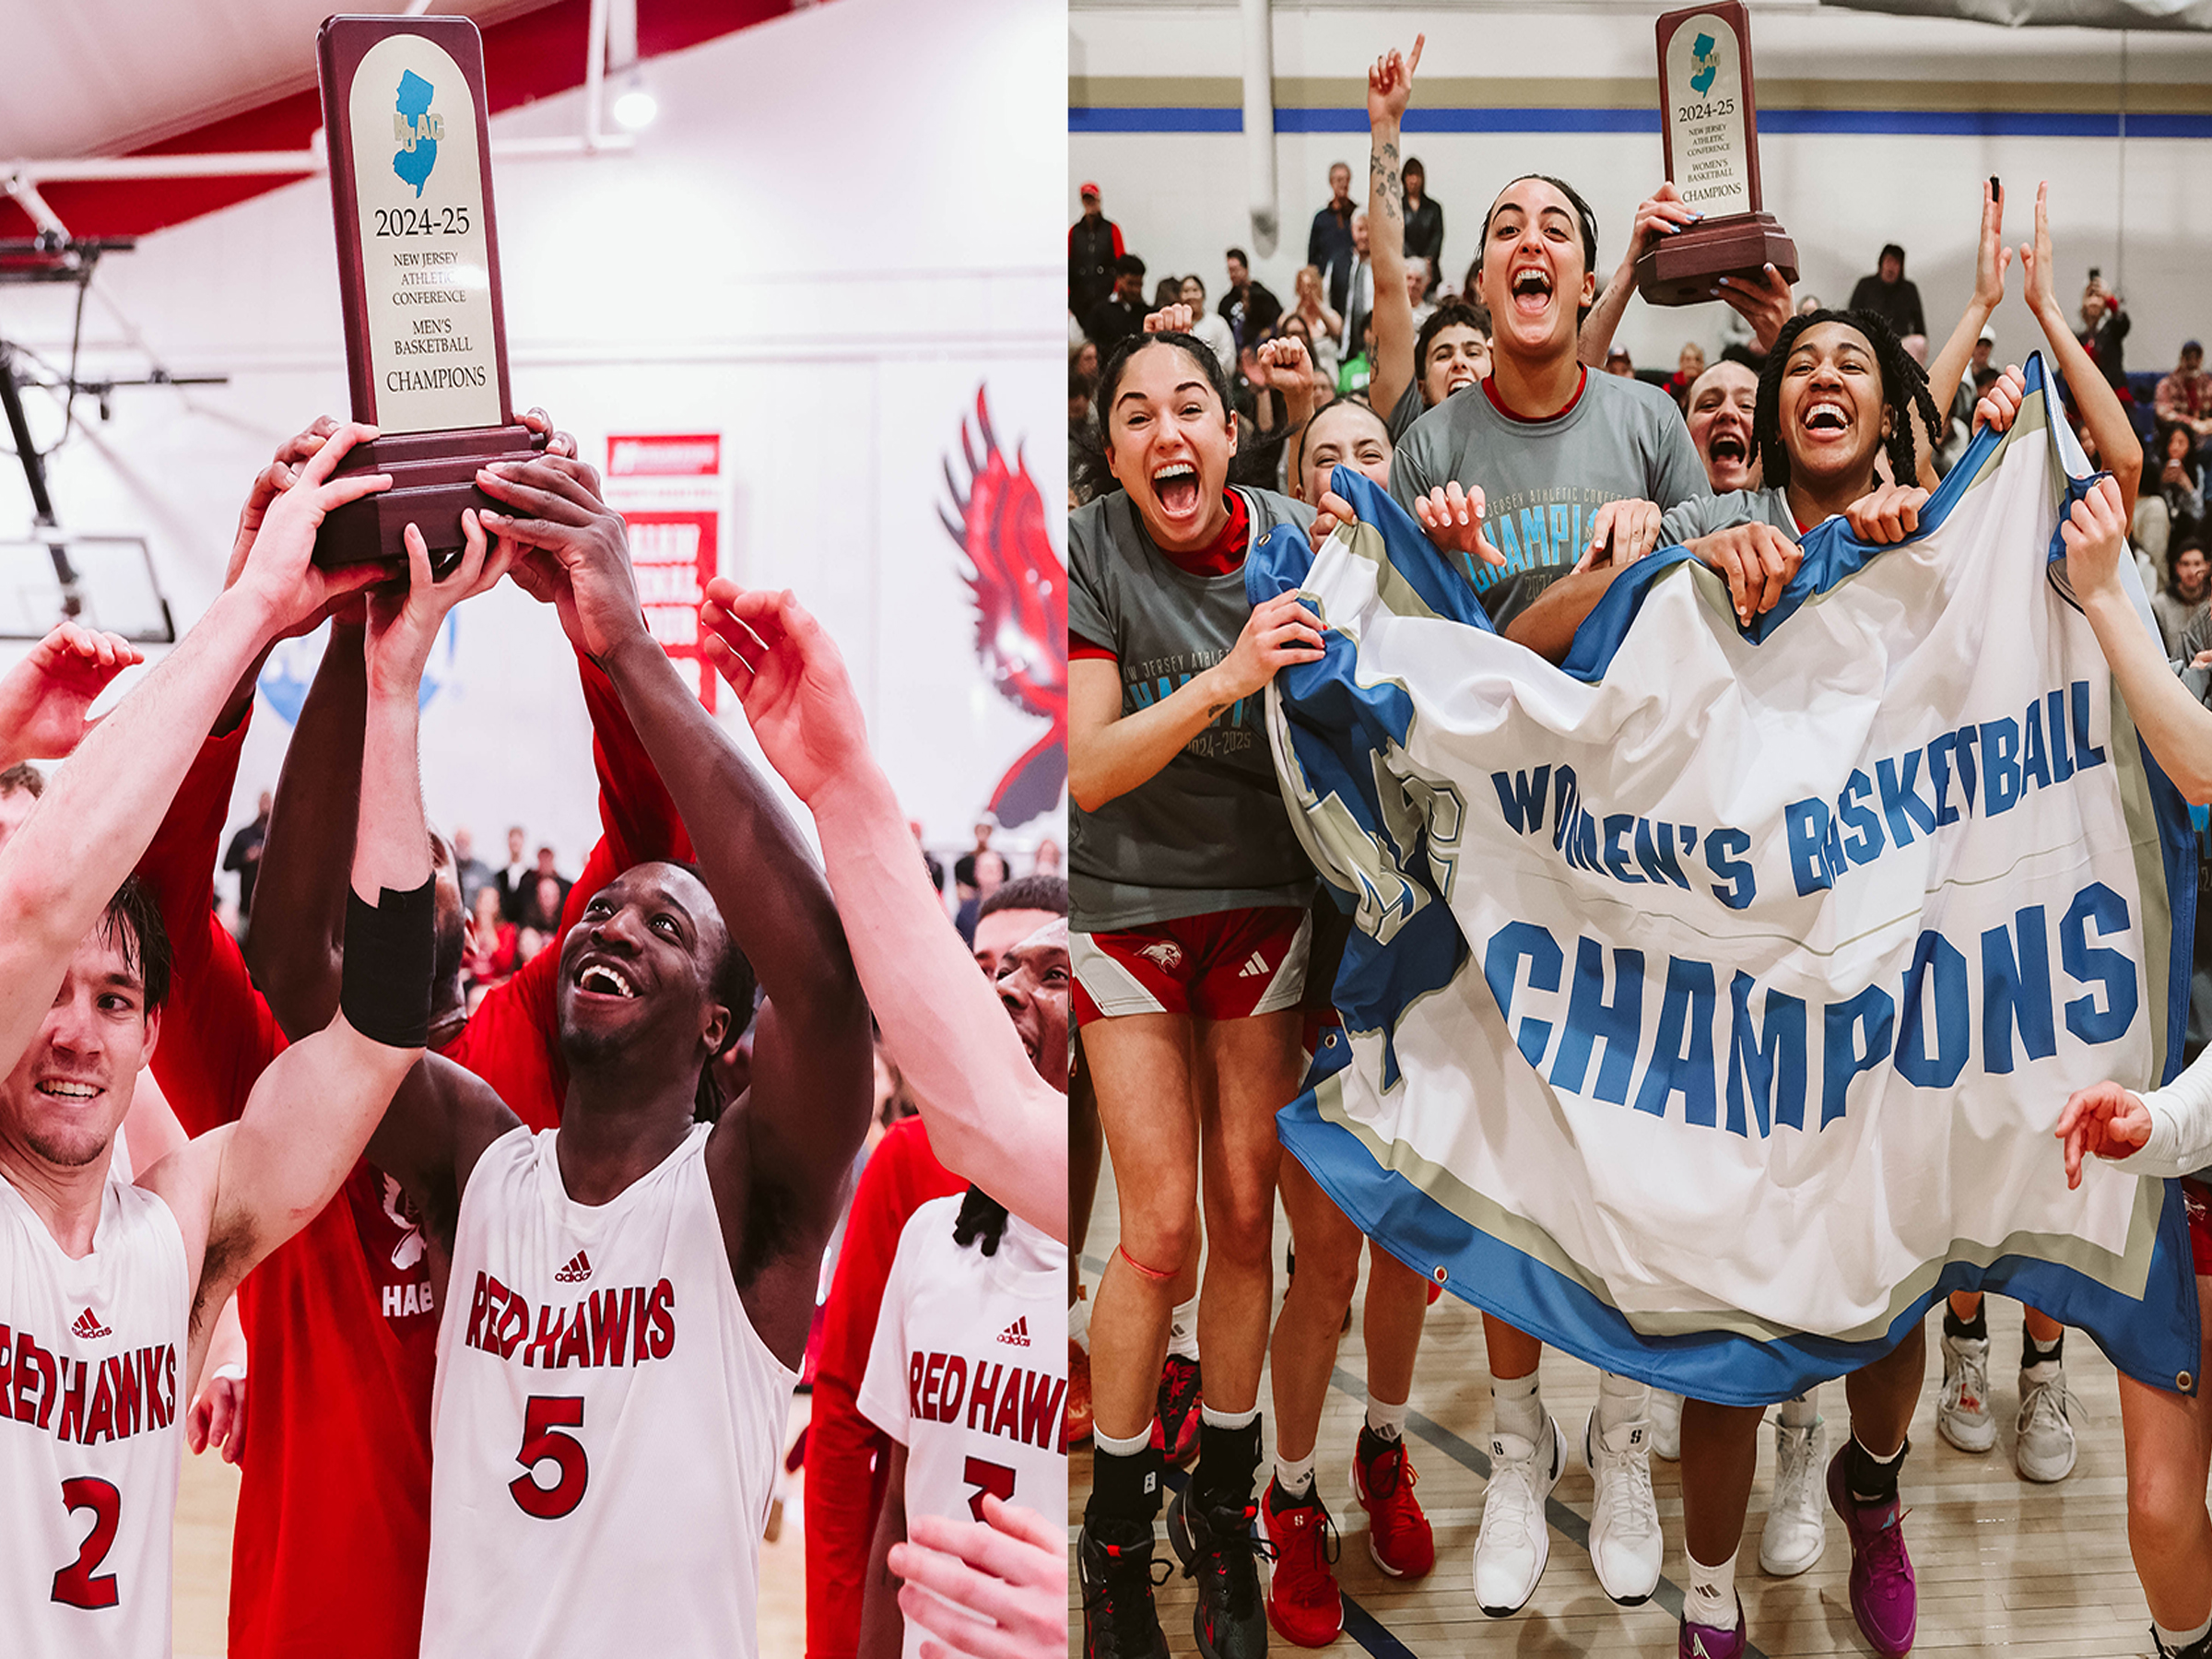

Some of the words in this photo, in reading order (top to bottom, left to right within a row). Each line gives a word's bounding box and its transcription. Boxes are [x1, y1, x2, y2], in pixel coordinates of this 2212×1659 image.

[1678, 98, 1735, 123] 2024-25
[1688, 127, 1704, 136] NEW
[1692, 134, 1724, 146] ATHLETIC
[1687, 143, 1731, 157] CONFERENCE
[1688, 168, 1733, 182] BASKETBALL
[1692, 159, 1728, 171] WOMEN'S
[1682, 182, 1742, 203] CHAMPIONS
[374, 207, 470, 237] 2024-25
[394, 253, 420, 266] NEW
[422, 252, 458, 267] JERSEY
[401, 271, 454, 286] ATHLETIC
[392, 290, 465, 306] CONFERENCE
[412, 318, 452, 335] MEN'S
[394, 337, 473, 355] BASKETBALL
[386, 366, 486, 392] CHAMPIONS
[1488, 492, 1524, 518] JERSEY
[1530, 487, 1578, 502] ATHLETIC
[1143, 653, 1184, 678] JERSEY
[1192, 649, 1230, 669] ATHLE
[1187, 731, 1252, 758] 024-2025
[1490, 763, 1758, 911] WOMEN'S
[1783, 680, 2107, 898] BASKETBALL
[1485, 880, 2139, 1139] CHAMPONS
[465, 1270, 530, 1361] RED
[523, 1277, 676, 1369] HAWKS
[996, 1334, 1031, 1347] adidas
[57, 1342, 176, 1446] HAWKS
[910, 1350, 968, 1424] RED
[508, 1394, 589, 1521] 5
[51, 1476, 120, 1610] 2
